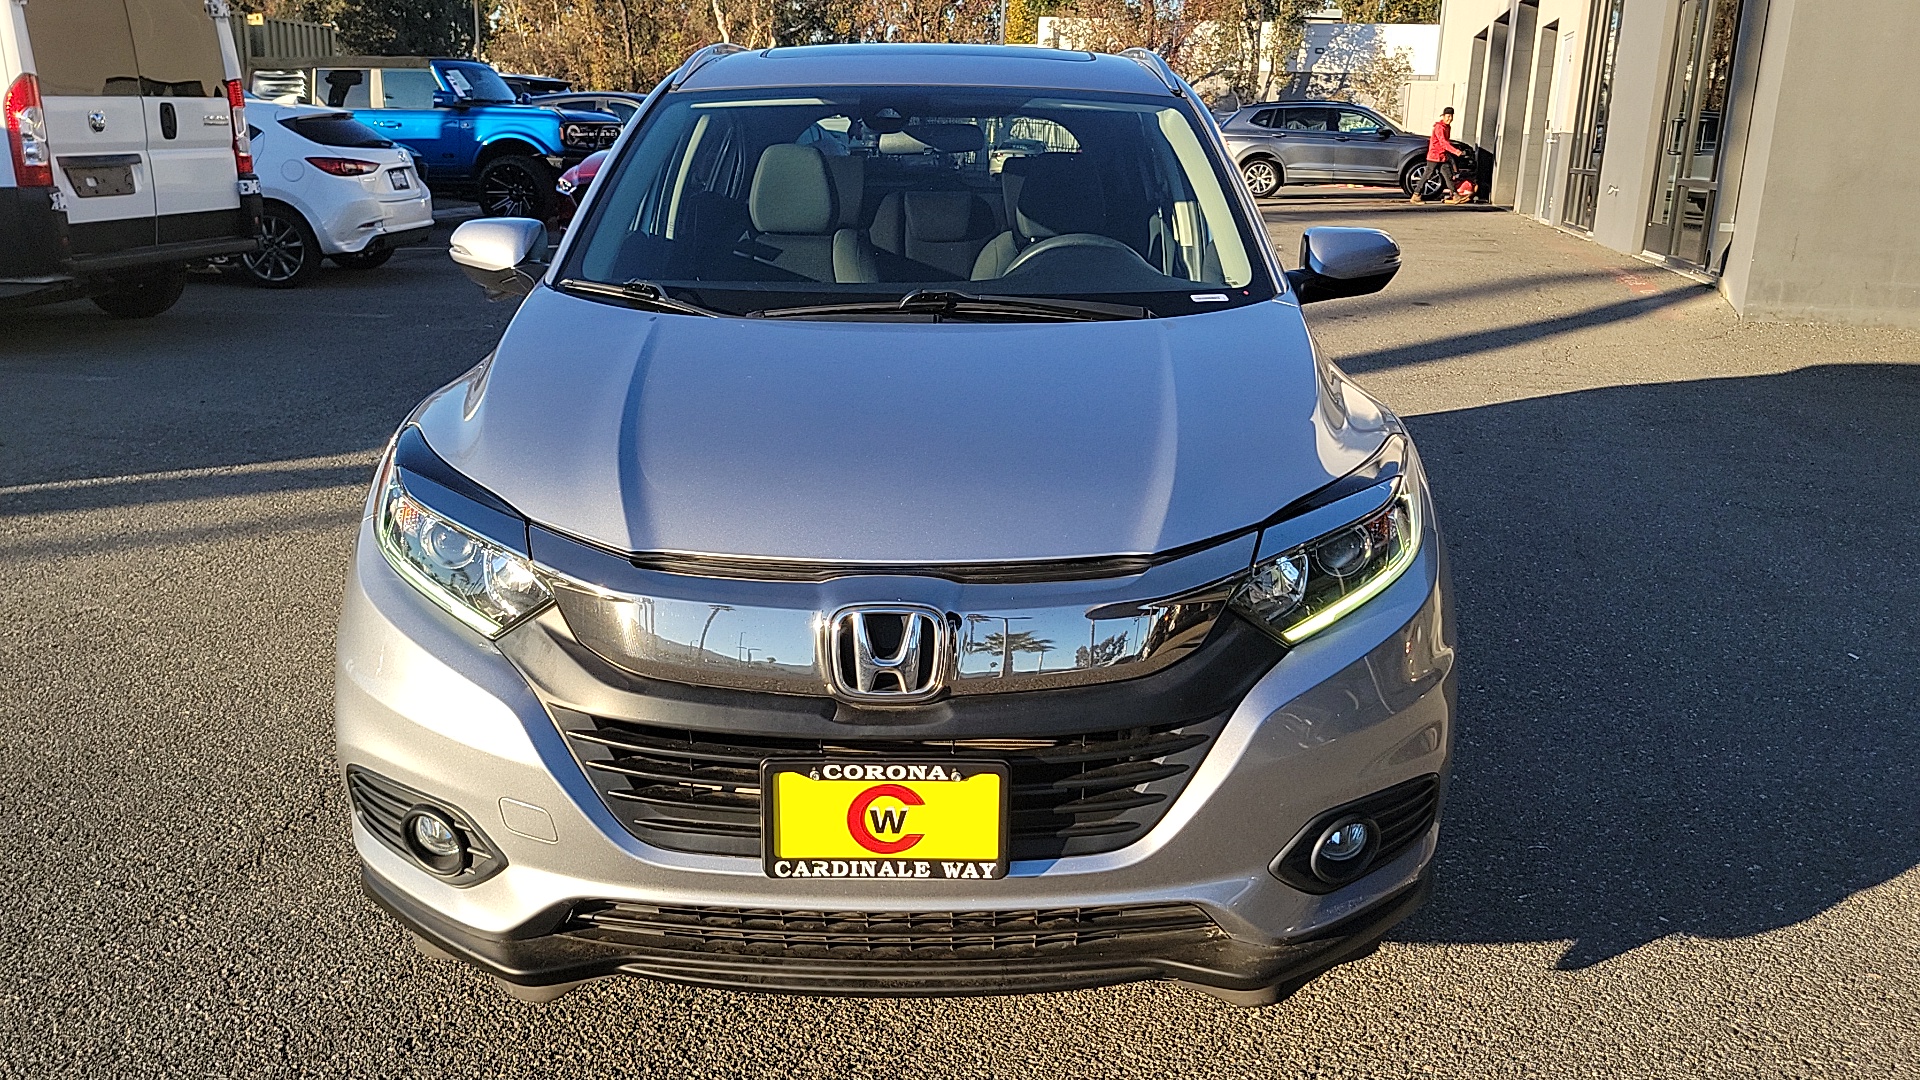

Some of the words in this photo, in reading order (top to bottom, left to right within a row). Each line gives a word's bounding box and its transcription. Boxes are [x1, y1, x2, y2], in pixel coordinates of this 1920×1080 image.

[822, 764, 949, 781] CORONA
[869, 806, 909, 834] W
[774, 860, 931, 878] CARDINALE
[941, 862, 998, 879] WAY
